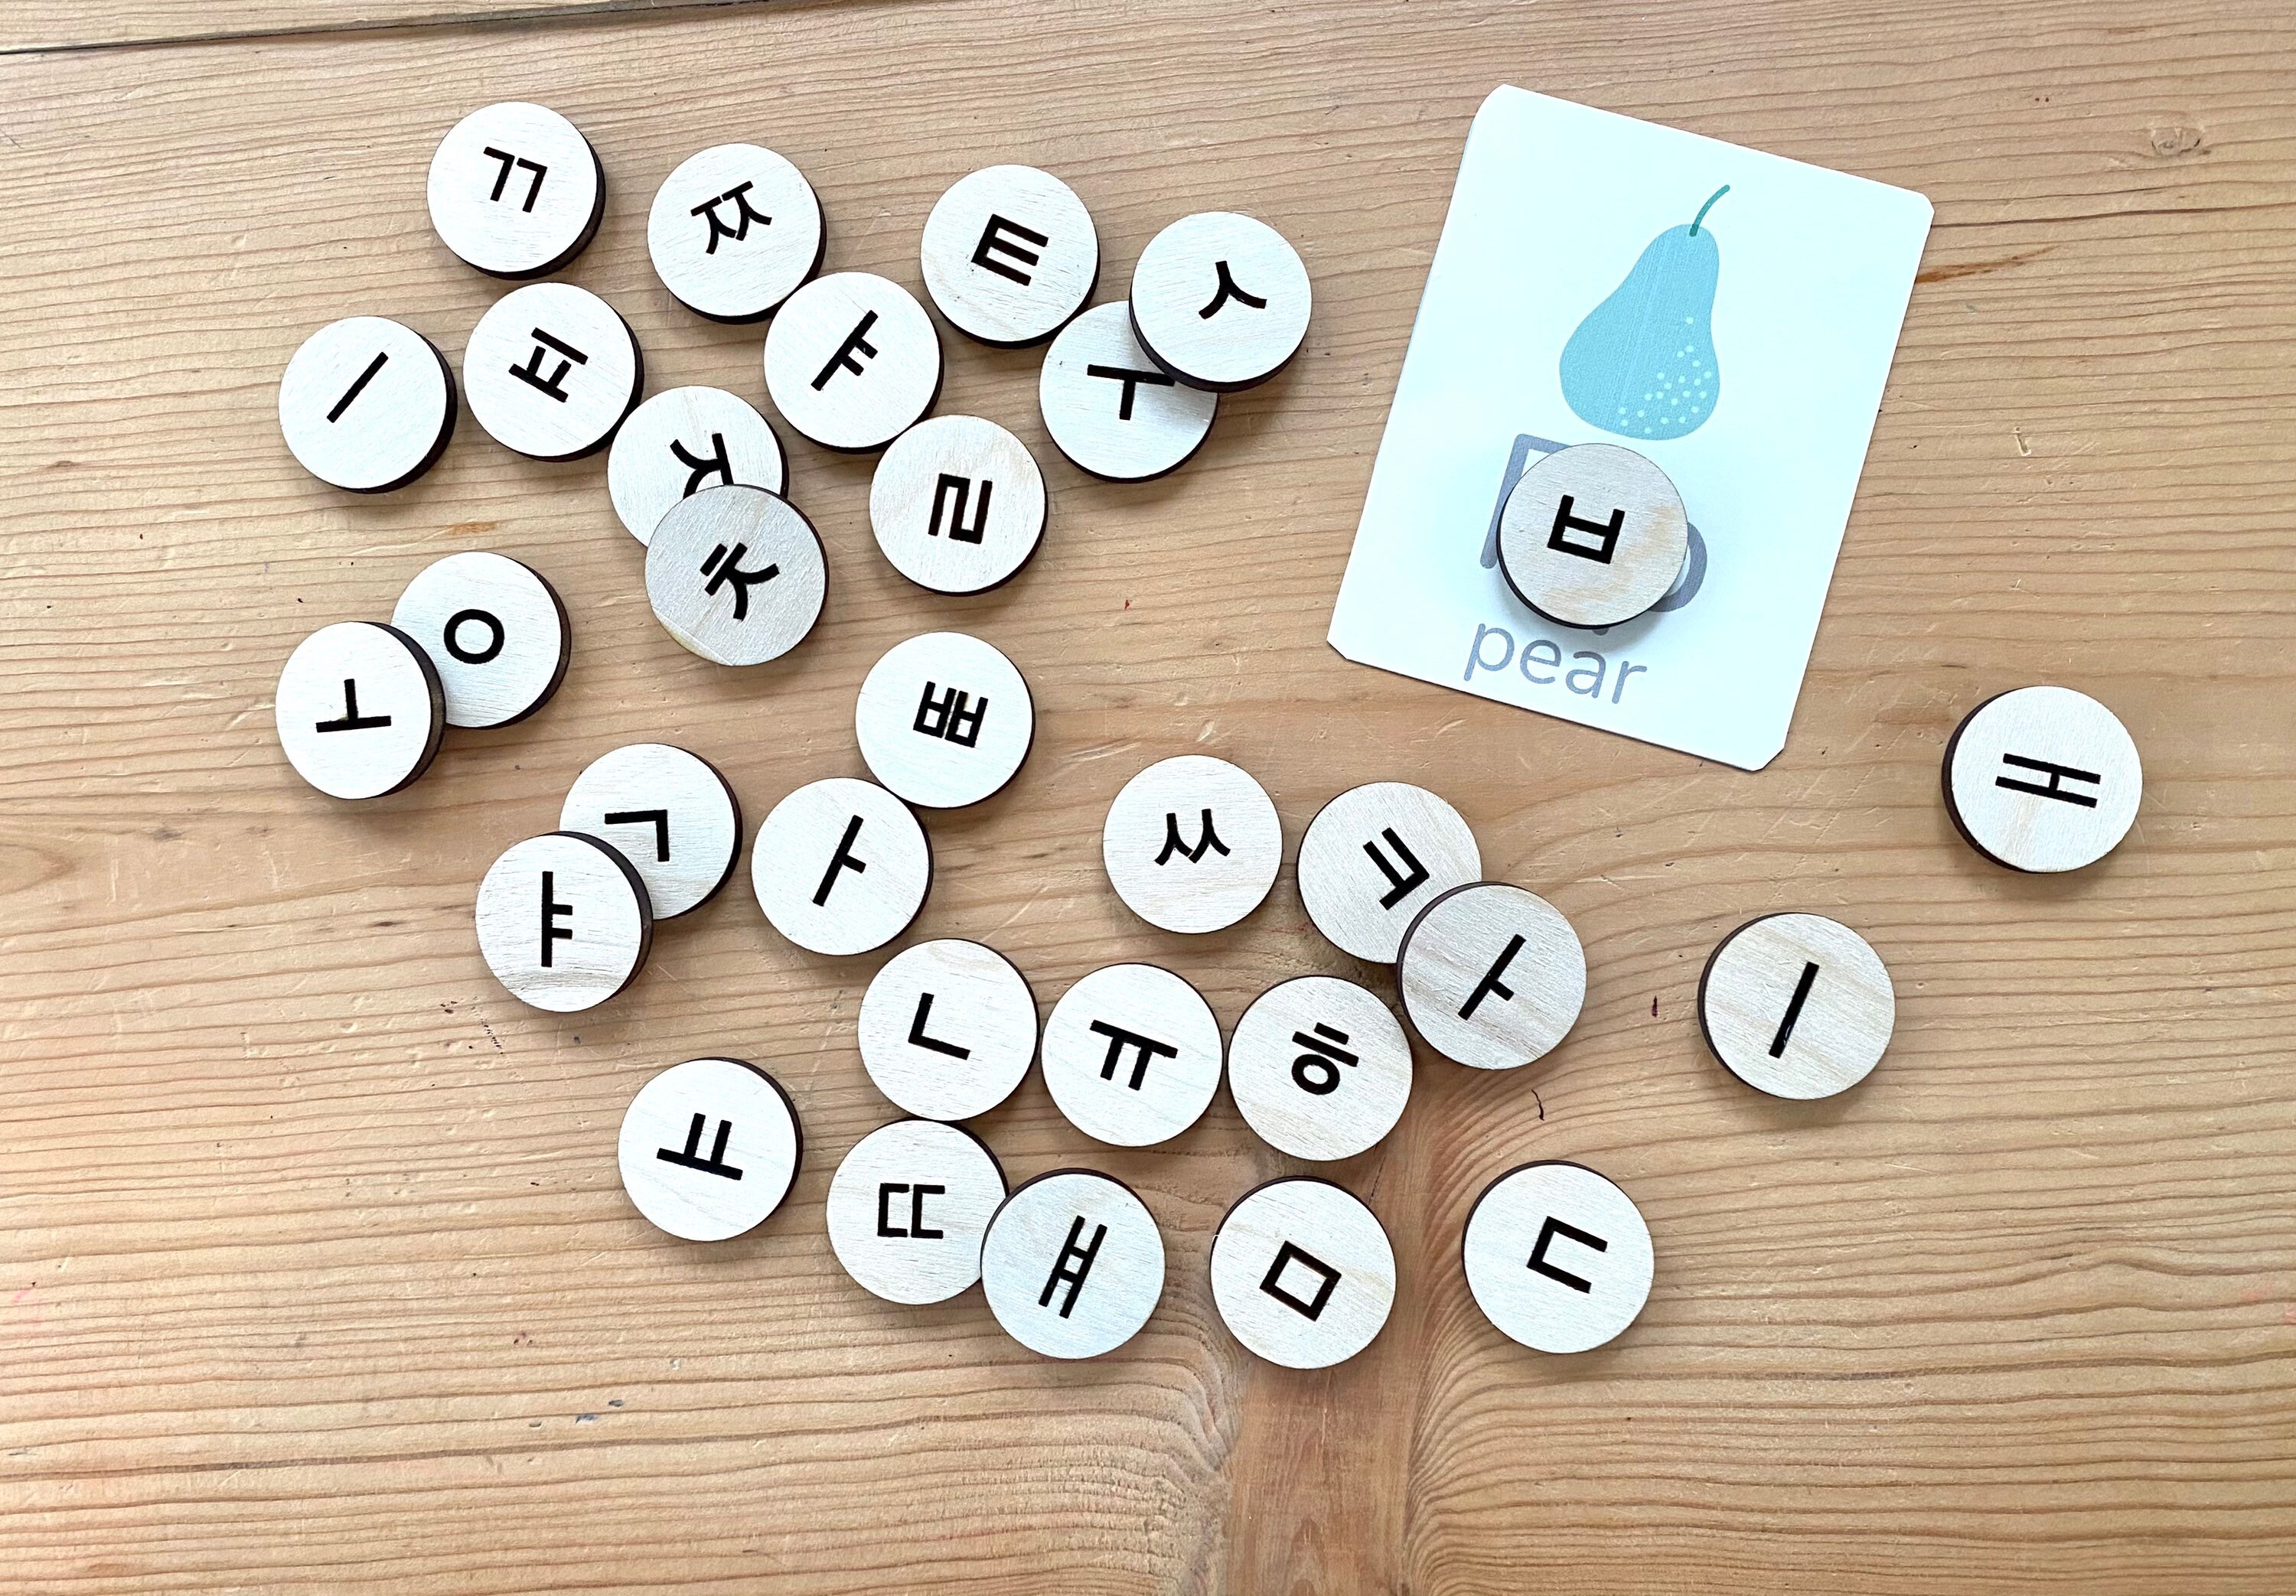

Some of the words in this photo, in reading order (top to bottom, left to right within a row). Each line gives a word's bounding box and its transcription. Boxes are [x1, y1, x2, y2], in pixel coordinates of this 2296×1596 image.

[484, 147, 548, 213] ㄲ
[691, 181, 772, 255] ㅉ
[971, 214, 1049, 286] ㅌ
[1199, 261, 1267, 320] ㅅ
[509, 327, 589, 403] ㅍ
[928, 474, 993, 545] ㄹ
[1548, 495, 1626, 565] ㅂ
[700, 542, 780, 622] ㅊ
[444, 609, 505, 665] ㅇ
[1463, 623, 1648, 705] pear
[913, 682, 989, 748] ㅃ
[1155, 809, 1231, 866] ㅆ
[1363, 828, 1430, 910] ㅋ
[1292, 1023, 1359, 1096] ㅎ
[878, 1183, 946, 1239] ㄸ
[1260, 1241, 1342, 1322] ㅁ
[1527, 1217, 1608, 1294] ㄷ
